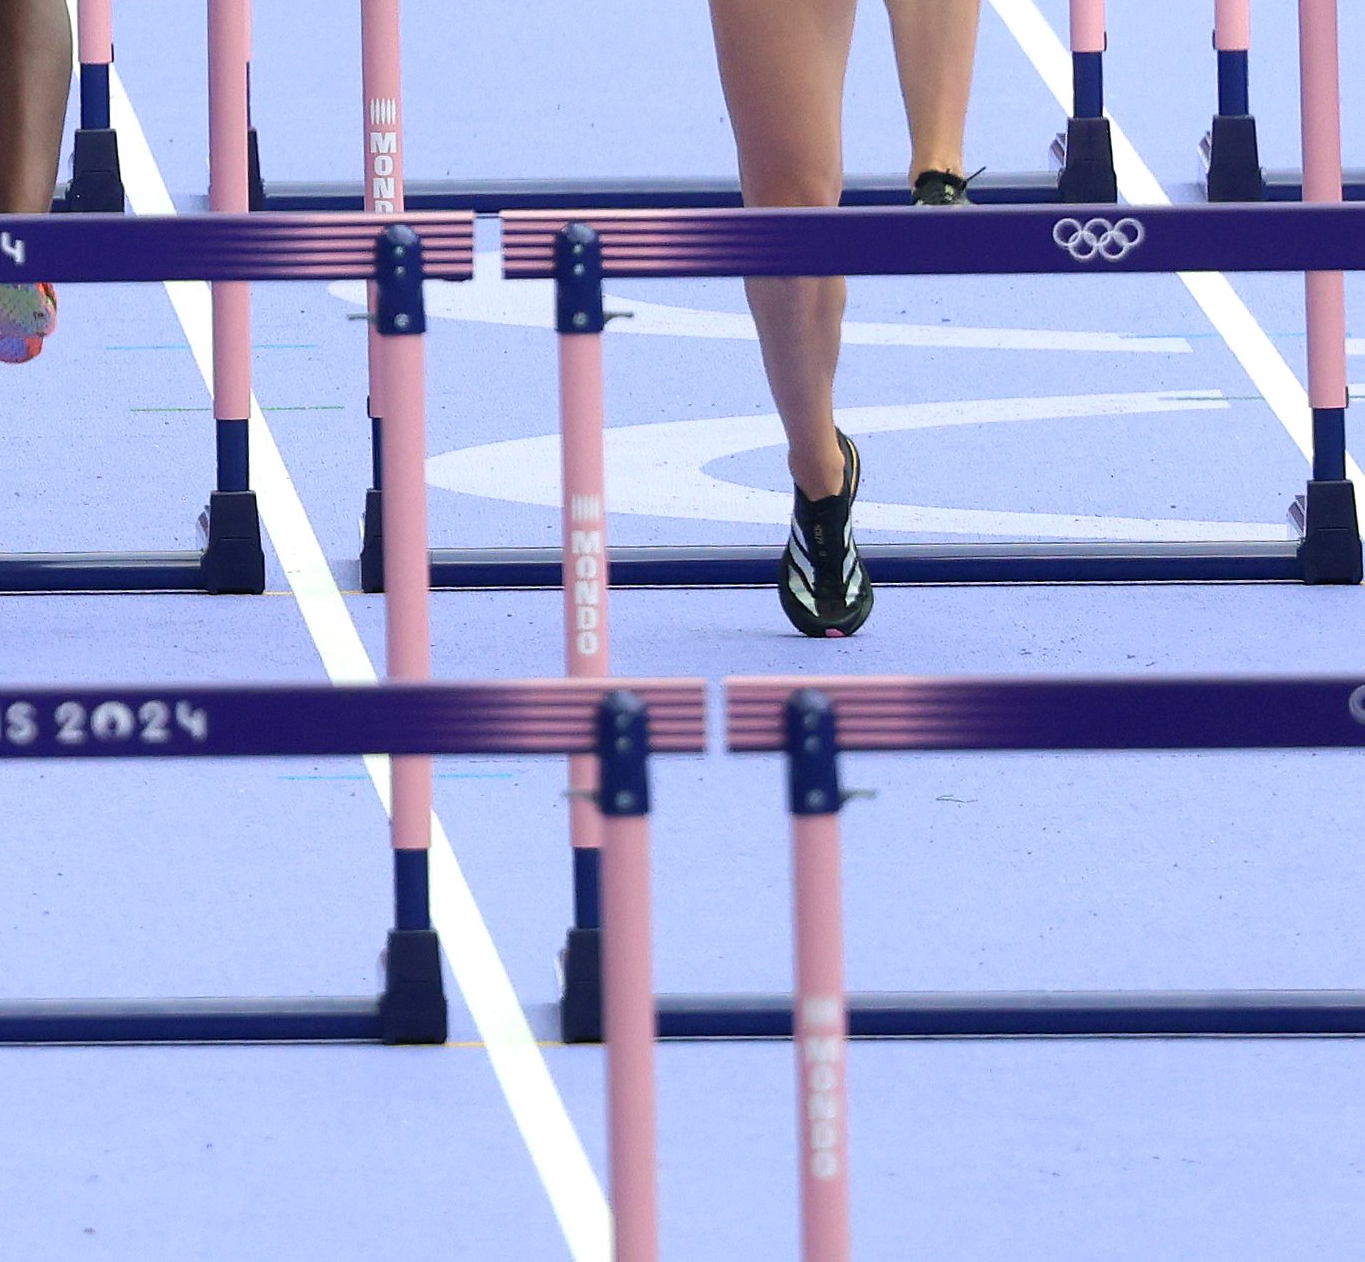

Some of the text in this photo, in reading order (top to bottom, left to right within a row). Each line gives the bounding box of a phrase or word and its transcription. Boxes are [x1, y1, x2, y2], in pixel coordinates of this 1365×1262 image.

[370, 132, 396, 214] MOND
[571, 530, 601, 656] MONDO
[55, 699, 208, 745] 2024
